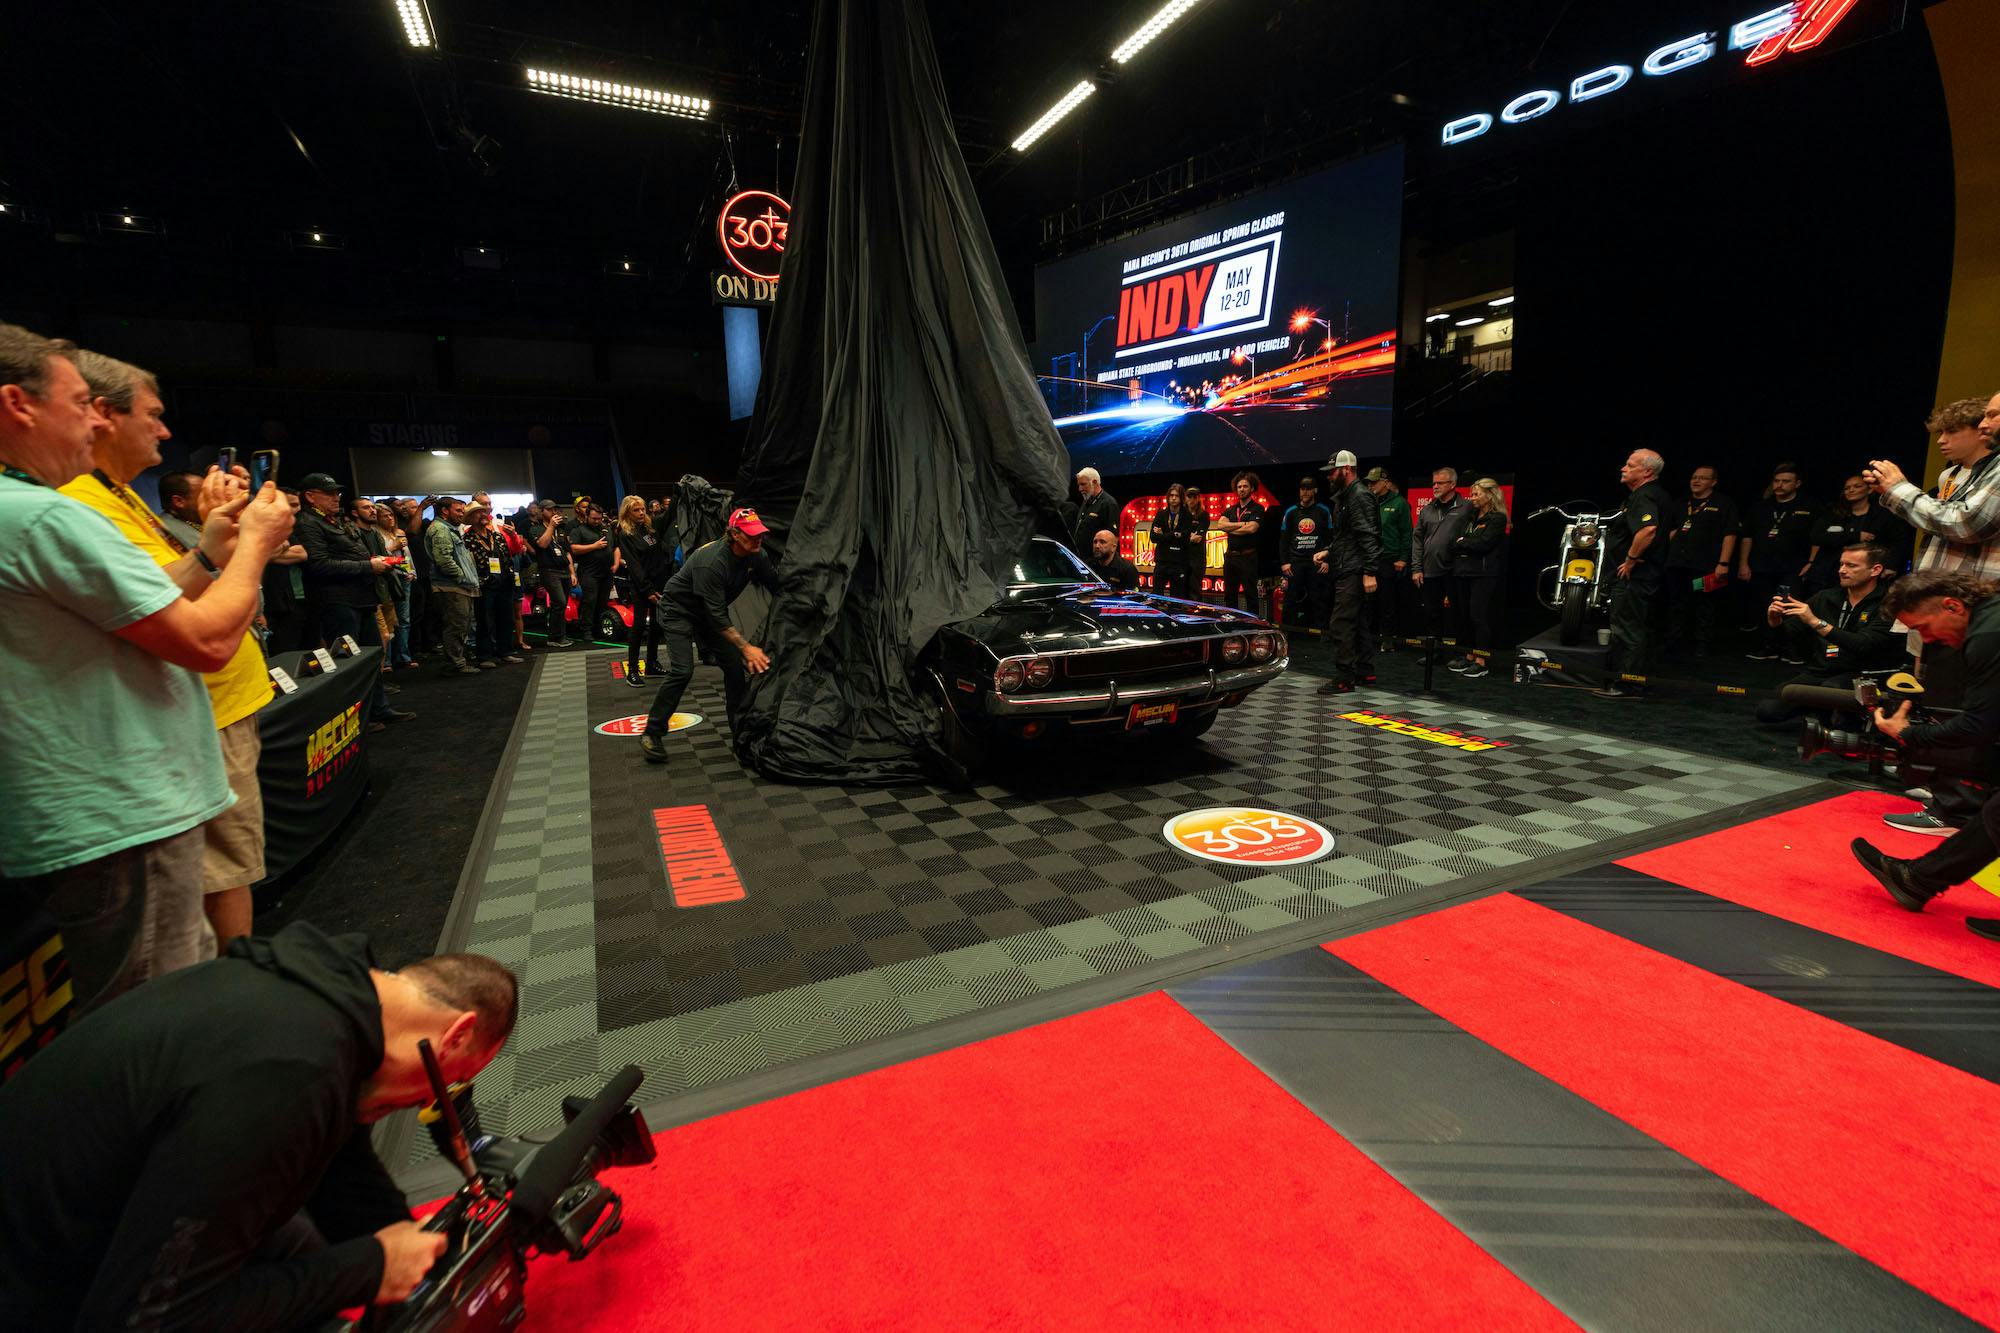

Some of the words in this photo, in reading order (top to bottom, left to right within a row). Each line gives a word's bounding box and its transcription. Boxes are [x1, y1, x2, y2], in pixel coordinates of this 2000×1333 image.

[1441, 1, 1801, 146] DODGE
[1123, 260, 1141, 273] DANA
[1141, 248, 1171, 269] MECUM'S
[1189, 234, 1222, 253] ORIGINAL
[1222, 222, 1251, 242] SPRING
[1250, 211, 1285, 234] CLASSIC
[716, 274, 748, 300] ON
[1226, 266, 1252, 290] MAY
[1116, 264, 1215, 347] INDY
[1221, 289, 1250, 311] 12-20
[1097, 370, 1118, 382] INDIANA
[1118, 366, 1135, 379] STATE
[1135, 359, 1173, 376] FAIRGROUNDS
[1221, 348, 1231, 360] IN
[1256, 336, 1290, 354] VEHICLES
[369, 423, 459, 446] STAGING
[1621, 673, 1646, 683] MECUM
[1717, 684, 1746, 695] MECUM
[1135, 703, 1176, 719] MECUM
[1182, 816, 1306, 853] 303
[653, 804, 747, 907] MOTORTREND
